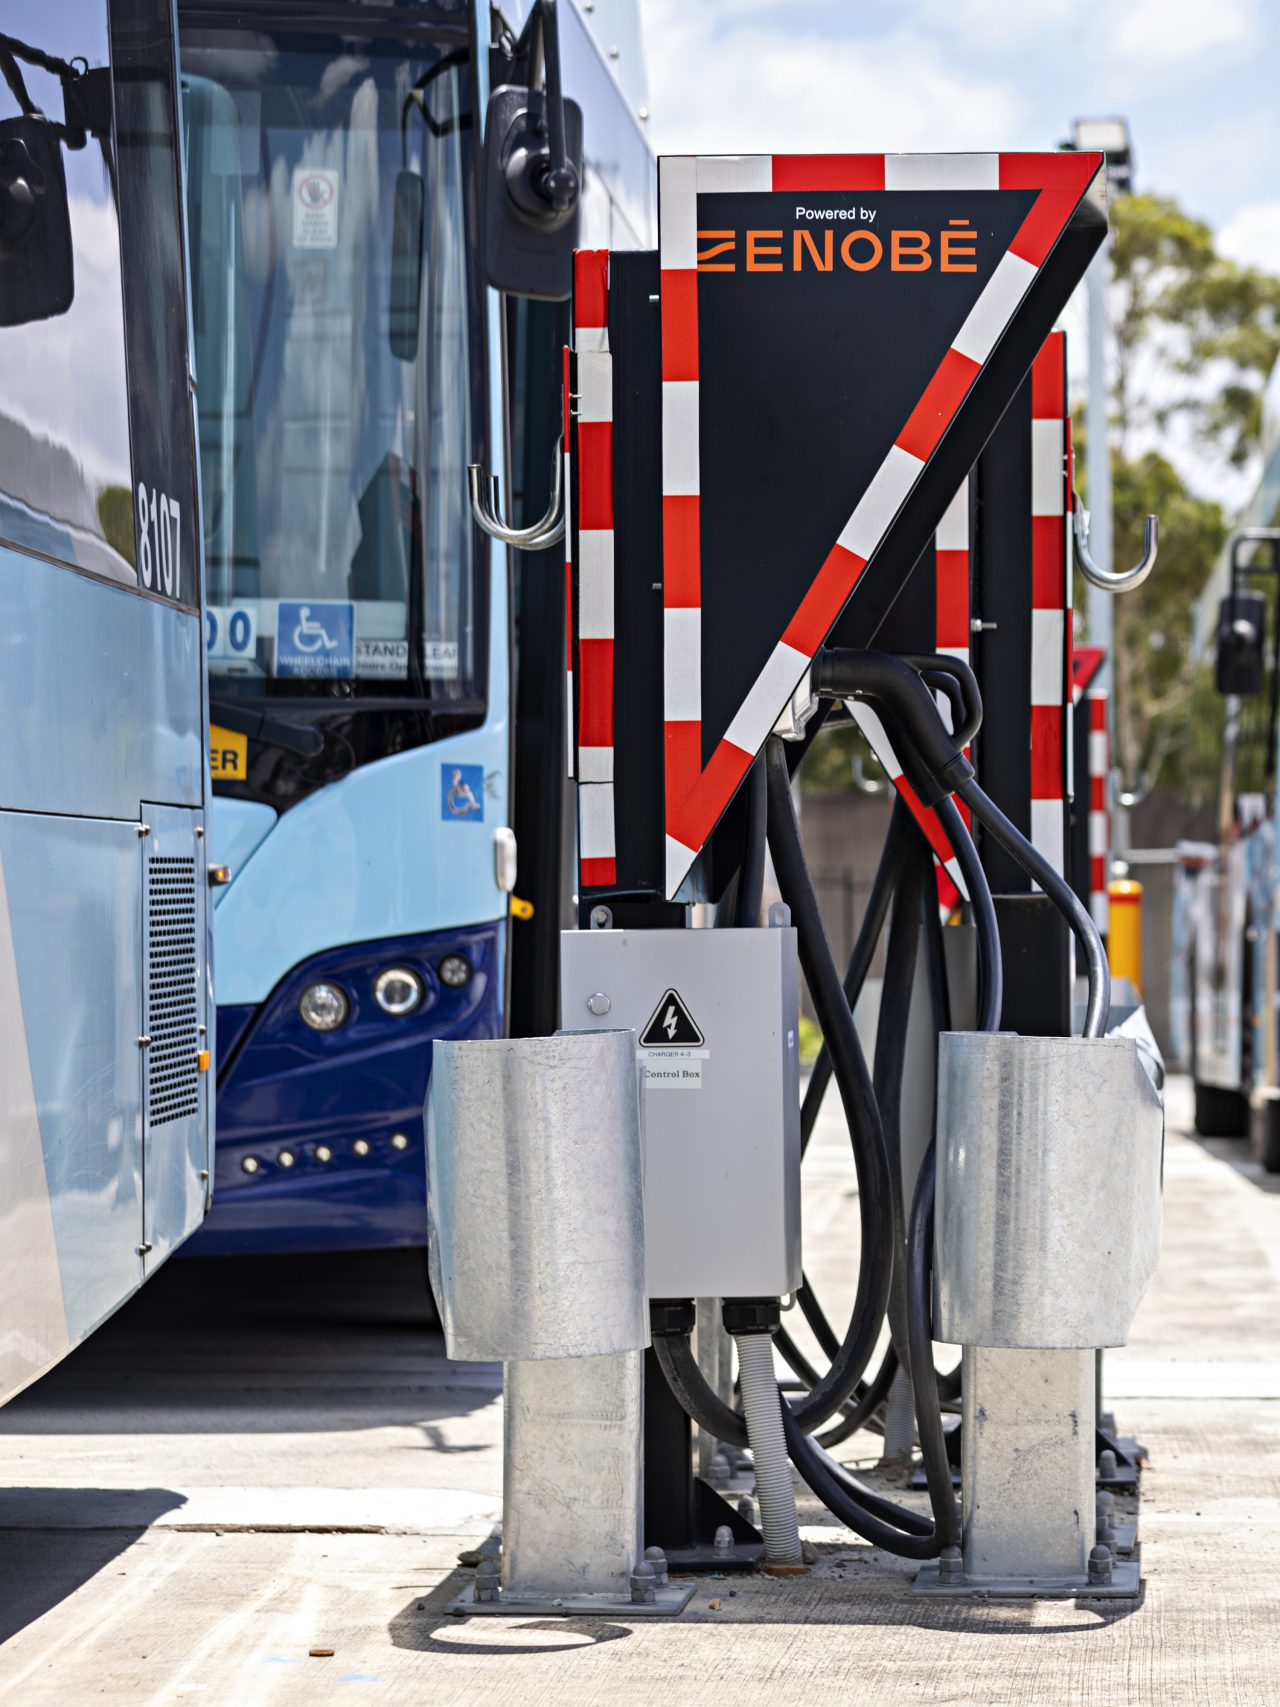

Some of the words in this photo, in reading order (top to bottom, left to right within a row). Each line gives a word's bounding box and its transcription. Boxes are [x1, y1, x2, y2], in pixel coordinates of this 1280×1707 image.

[796, 207, 855, 220] Powered
[860, 207, 876, 222] by
[138, 481, 181, 599] 8107
[644, 1070, 680, 1078] Control
[682, 1070, 700, 1078] Box
